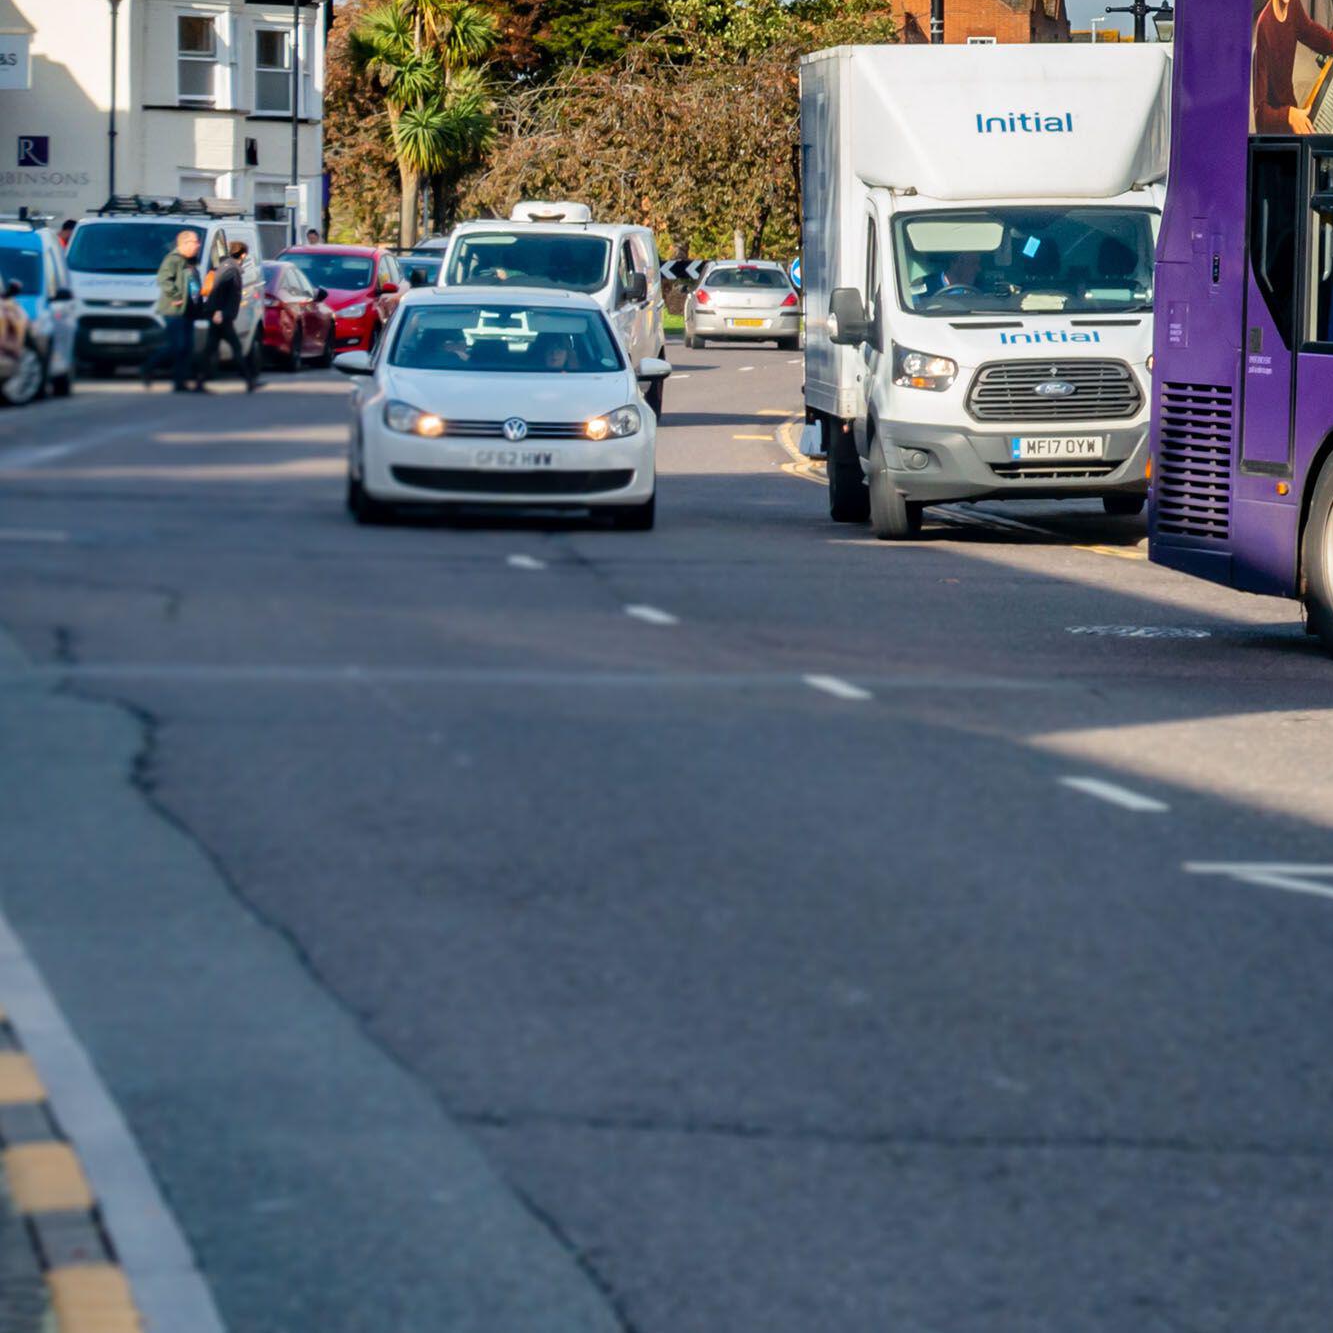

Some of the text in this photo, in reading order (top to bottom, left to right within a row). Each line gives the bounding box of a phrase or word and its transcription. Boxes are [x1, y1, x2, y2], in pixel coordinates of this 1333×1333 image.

[976, 111, 1074, 134] Initial
[1000, 329, 1101, 345] Initial
[1026, 439, 1096, 455] MF17 OYW
